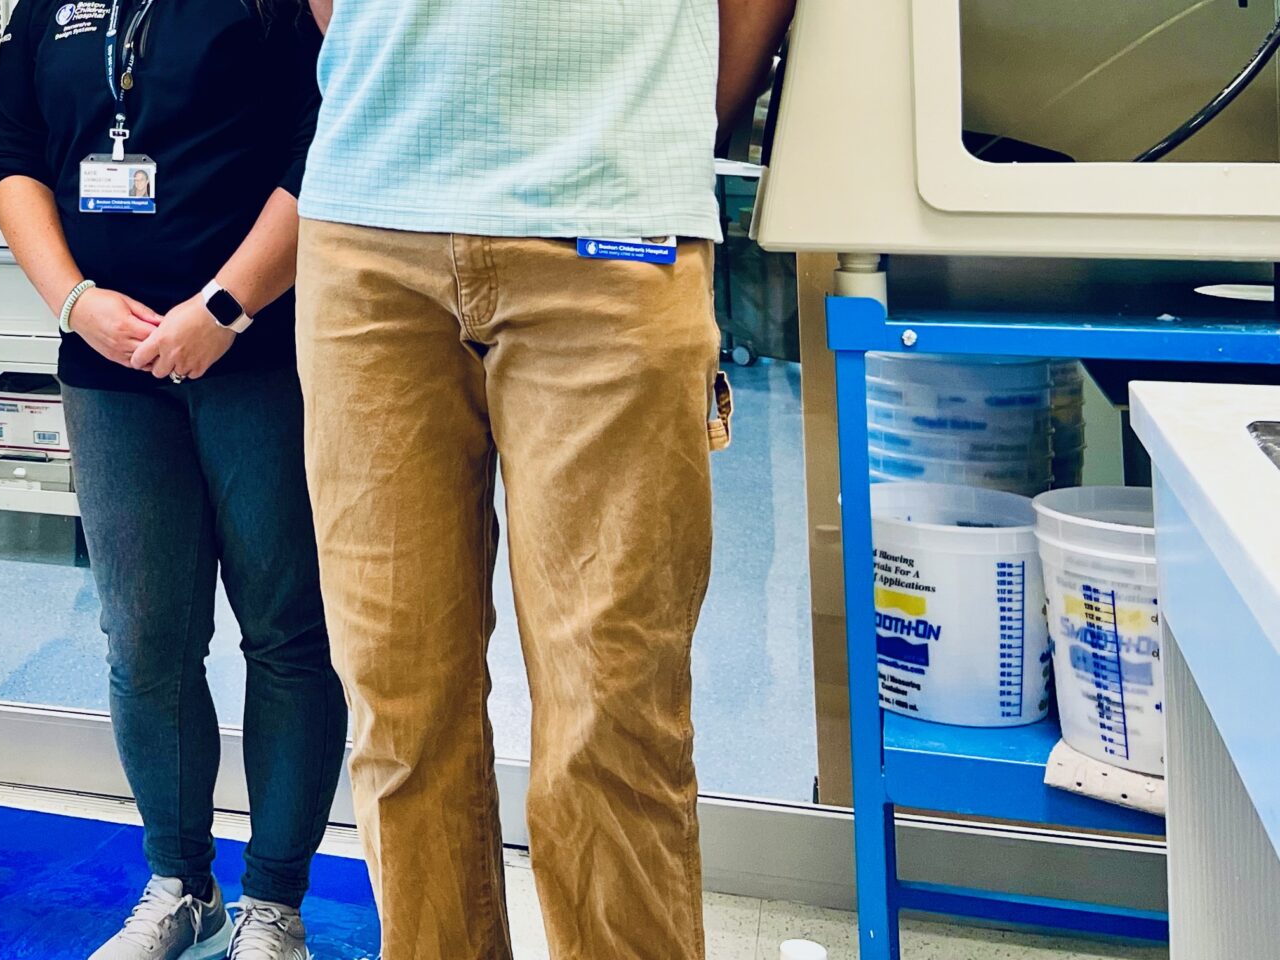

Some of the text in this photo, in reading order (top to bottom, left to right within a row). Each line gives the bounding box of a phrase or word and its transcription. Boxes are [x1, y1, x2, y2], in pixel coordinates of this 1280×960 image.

[879, 550, 915, 567] Blowing
[894, 566, 911, 576] For
[913, 570, 920, 579] A
[879, 575, 936, 592] Applications
